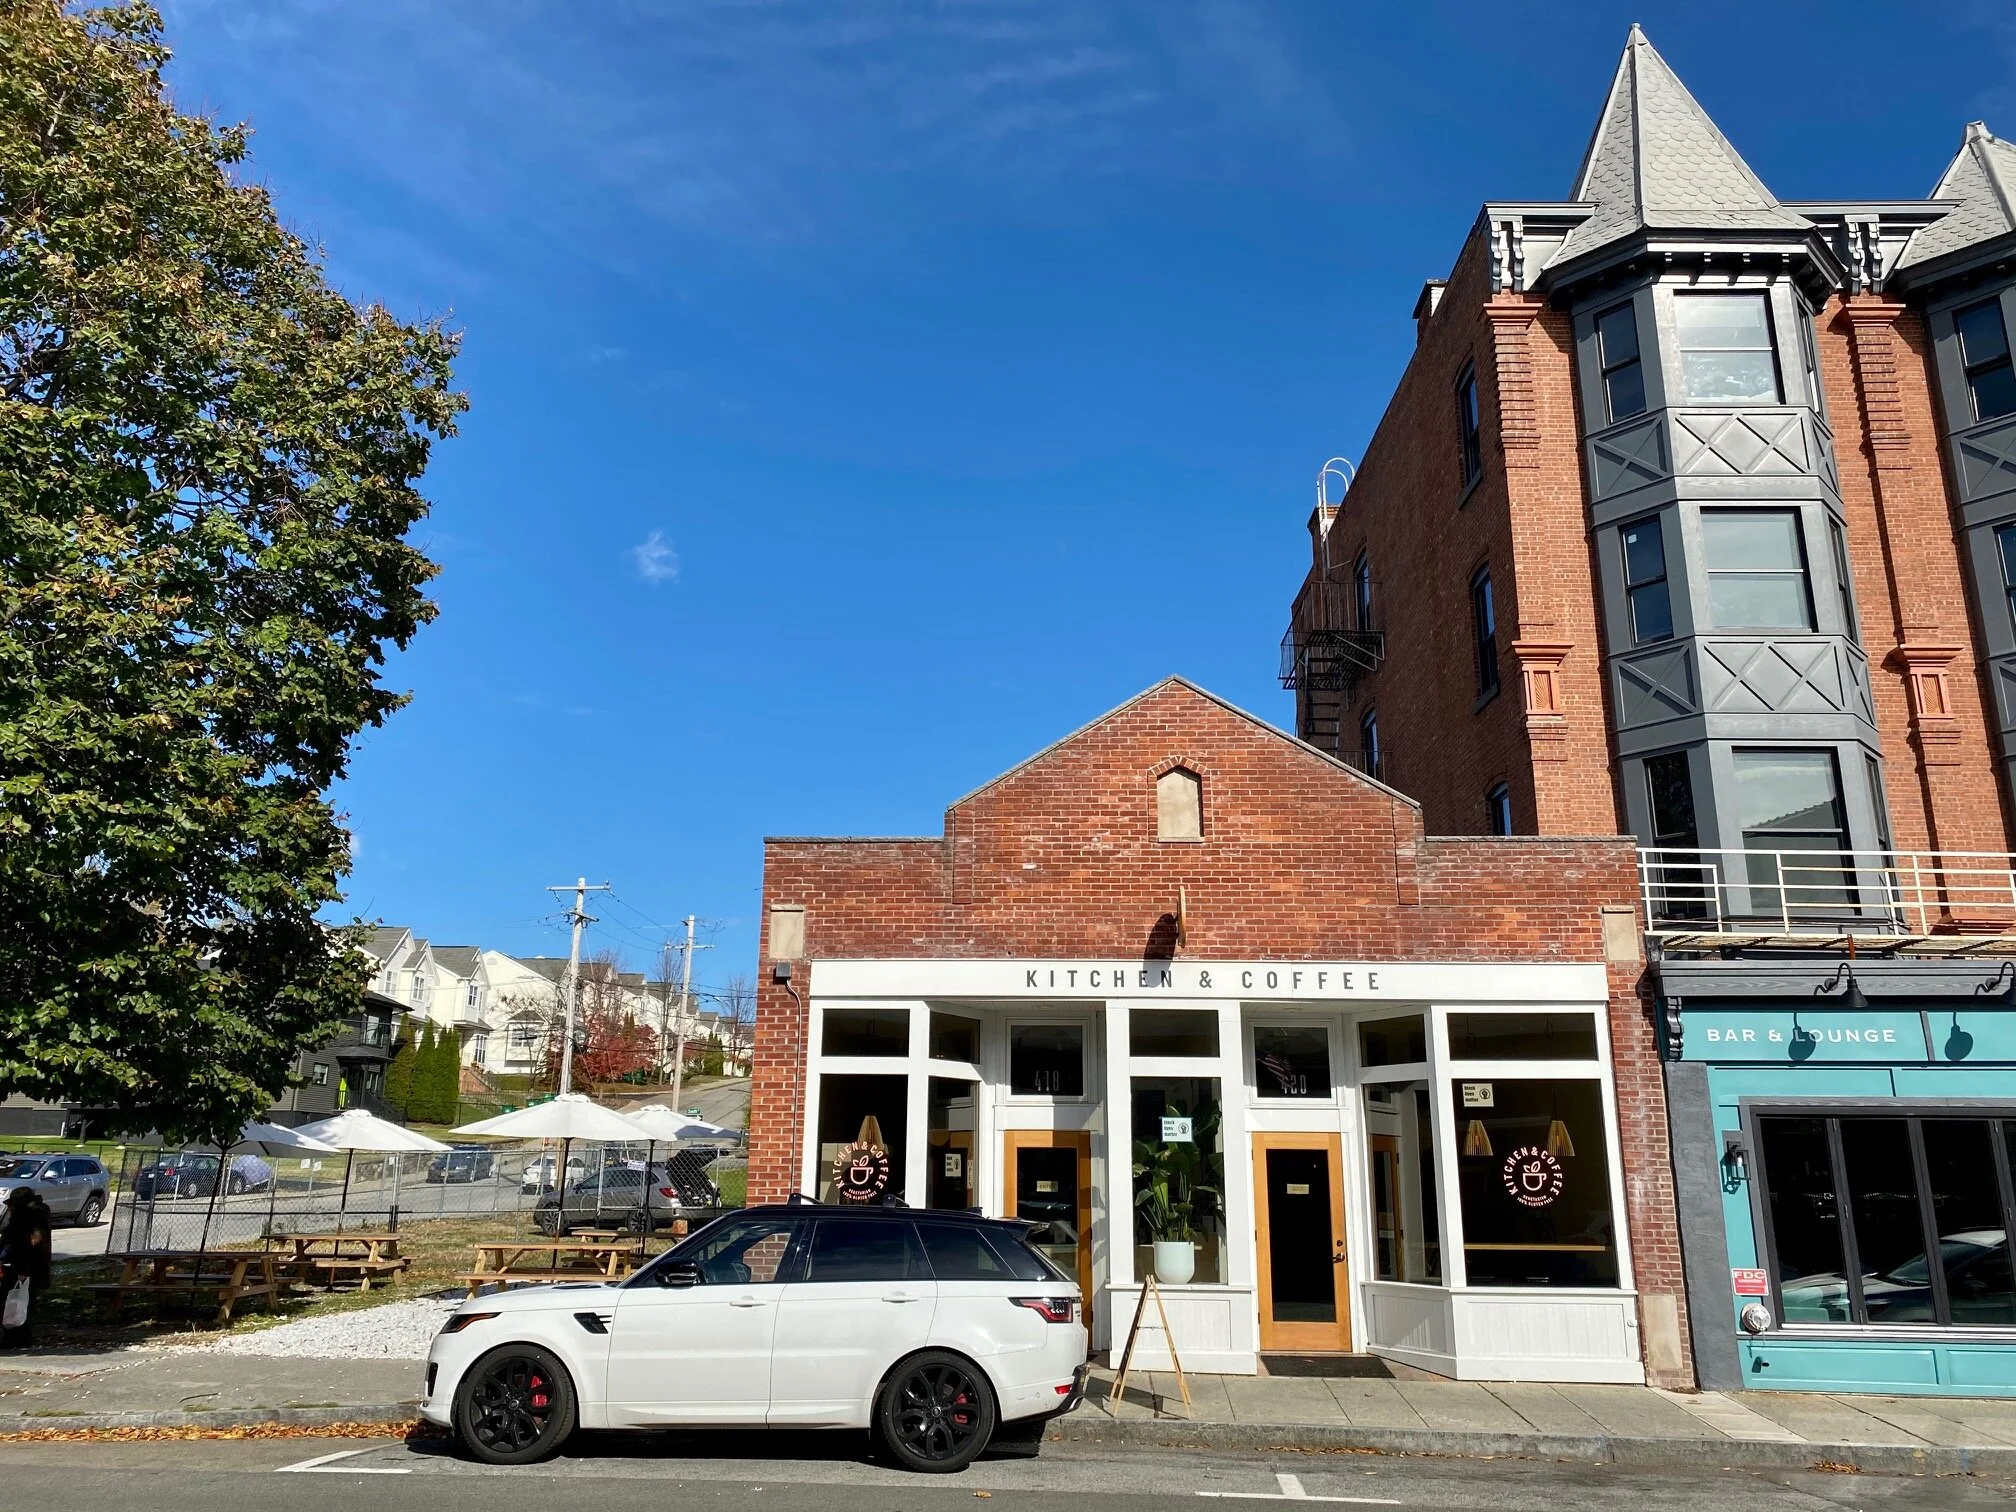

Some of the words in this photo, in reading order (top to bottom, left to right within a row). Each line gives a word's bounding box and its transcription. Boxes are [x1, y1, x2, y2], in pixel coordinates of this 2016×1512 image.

[1026, 969, 1172, 989] KITCHEN
[1199, 970, 1213, 989] &
[1241, 970, 1380, 990] COFFEE
[1706, 1028, 1757, 1042] BAR
[1768, 1028, 1783, 1043] &
[1793, 1028, 1897, 1043] LOUNGE
[1034, 1069, 1060, 1092] 418
[1281, 1073, 1307, 1095] 420
[832, 1141, 859, 1189] KITCHEN
[861, 1141, 868, 1150] &
[870, 1144, 889, 1189] COFFEE
[1503, 1146, 1529, 1195] KITCHEN
[1530, 1146, 1539, 1156] &
[1540, 1150, 1563, 1196] COFFEE
[1734, 1270, 1766, 1280] FDC
